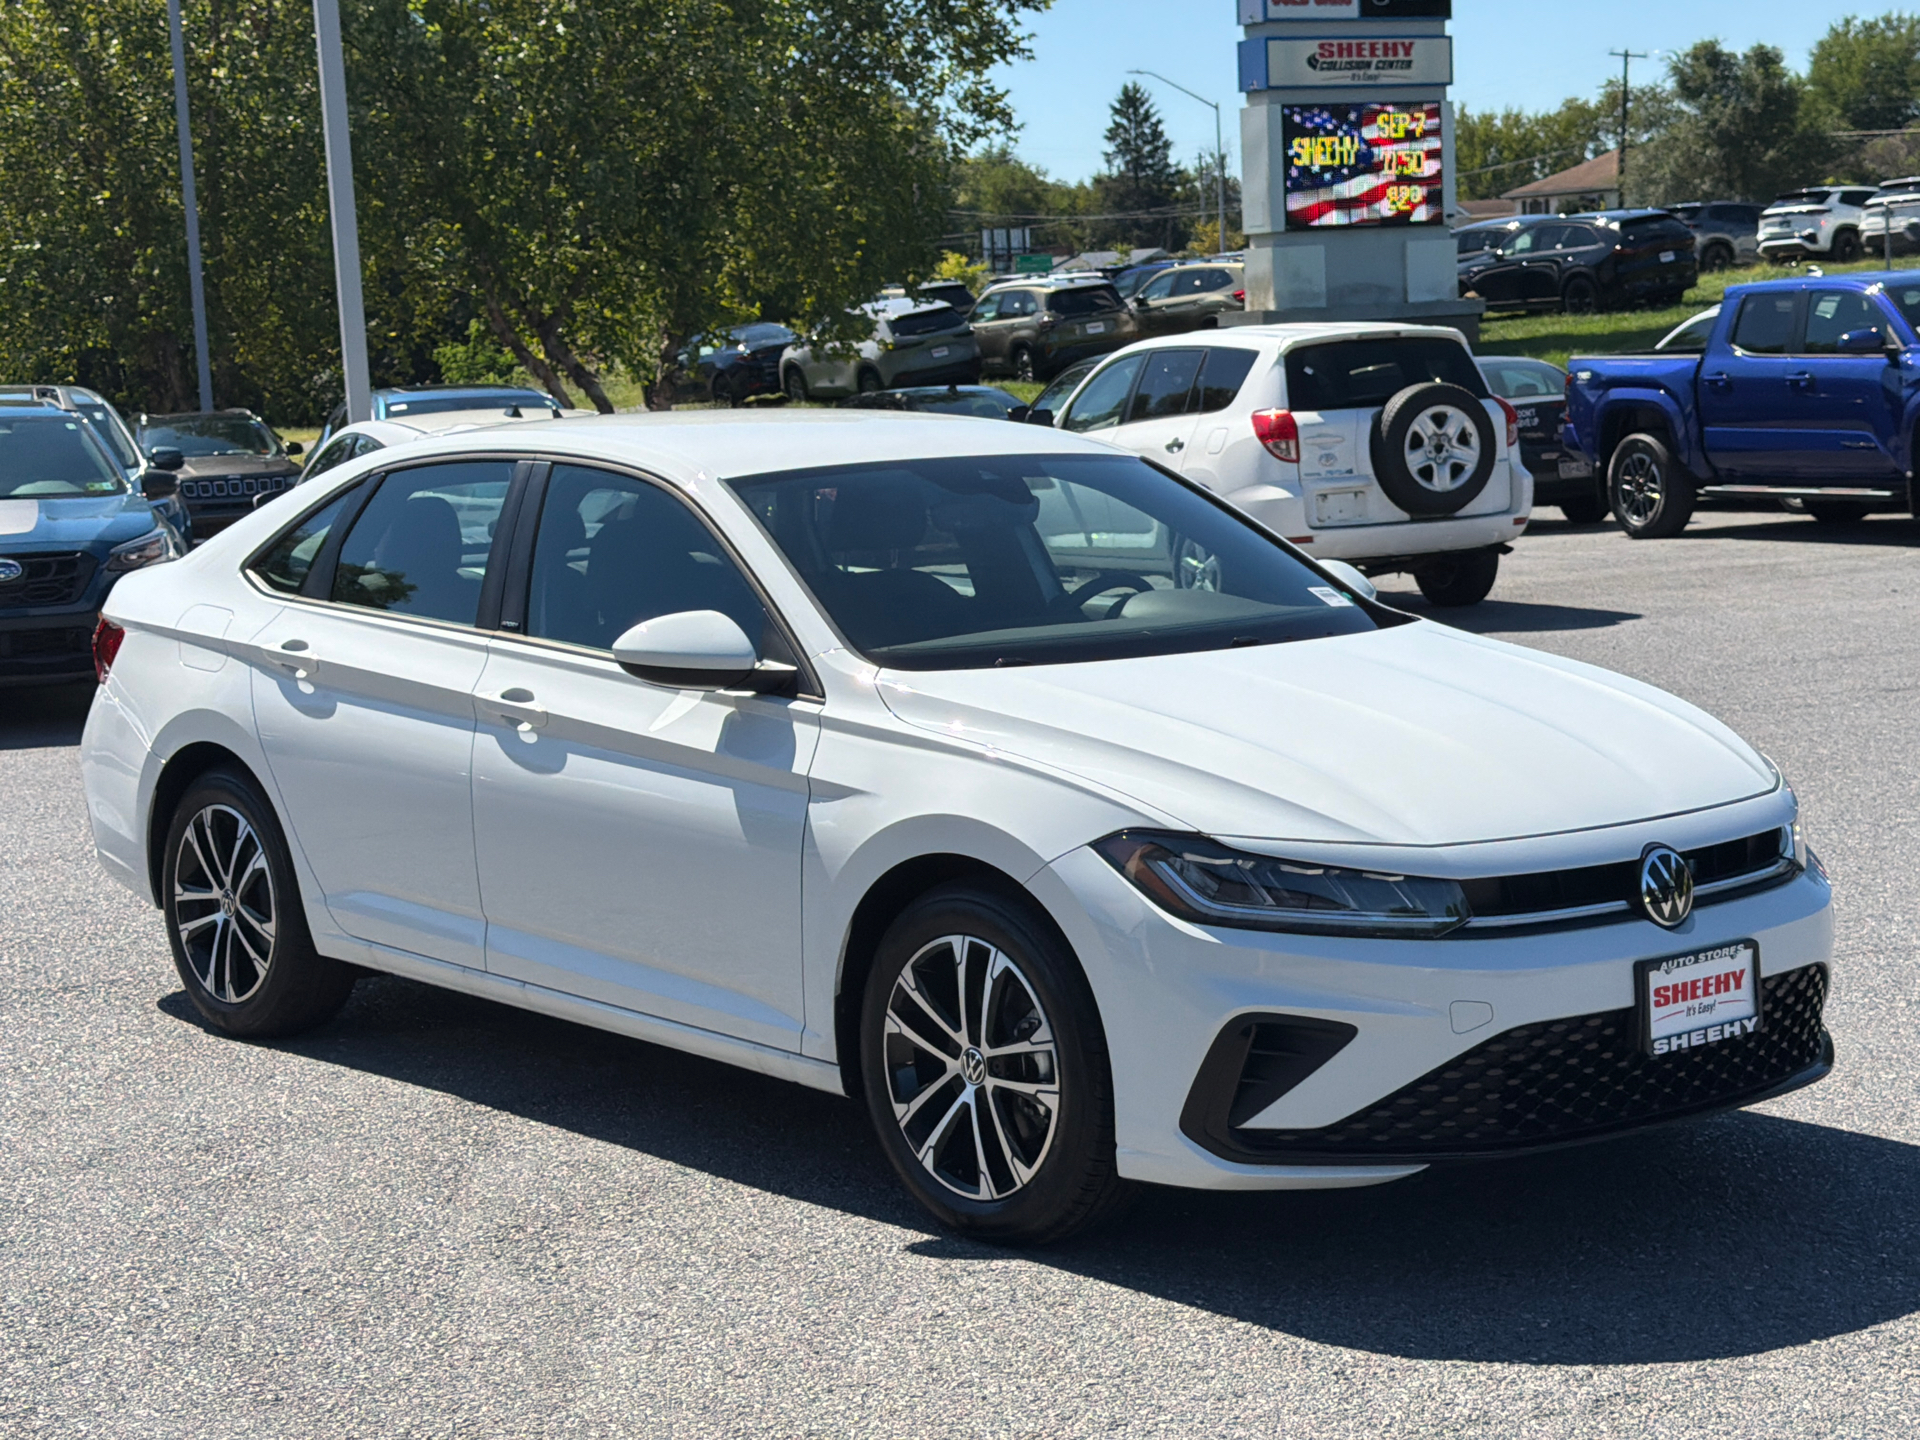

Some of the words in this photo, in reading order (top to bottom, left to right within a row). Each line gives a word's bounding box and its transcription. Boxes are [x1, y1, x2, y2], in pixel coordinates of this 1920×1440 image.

[1317, 41, 1415, 58] SHEEHY
[1319, 60, 1373, 72] COLLISION
[1374, 59, 1413, 71] CENTER
[1376, 112, 1410, 138] SEP
[1413, 112, 1426, 138] 7
[1292, 135, 1360, 166] SHEEHY
[1660, 955, 1695, 972] AUTO
[1698, 944, 1745, 963] STORES
[1653, 968, 1746, 1008] SHEEHY
[1686, 1004, 1697, 1018] It's
[1698, 998, 1717, 1015] Easy!
[1653, 1016, 1758, 1056] SHEEHY
